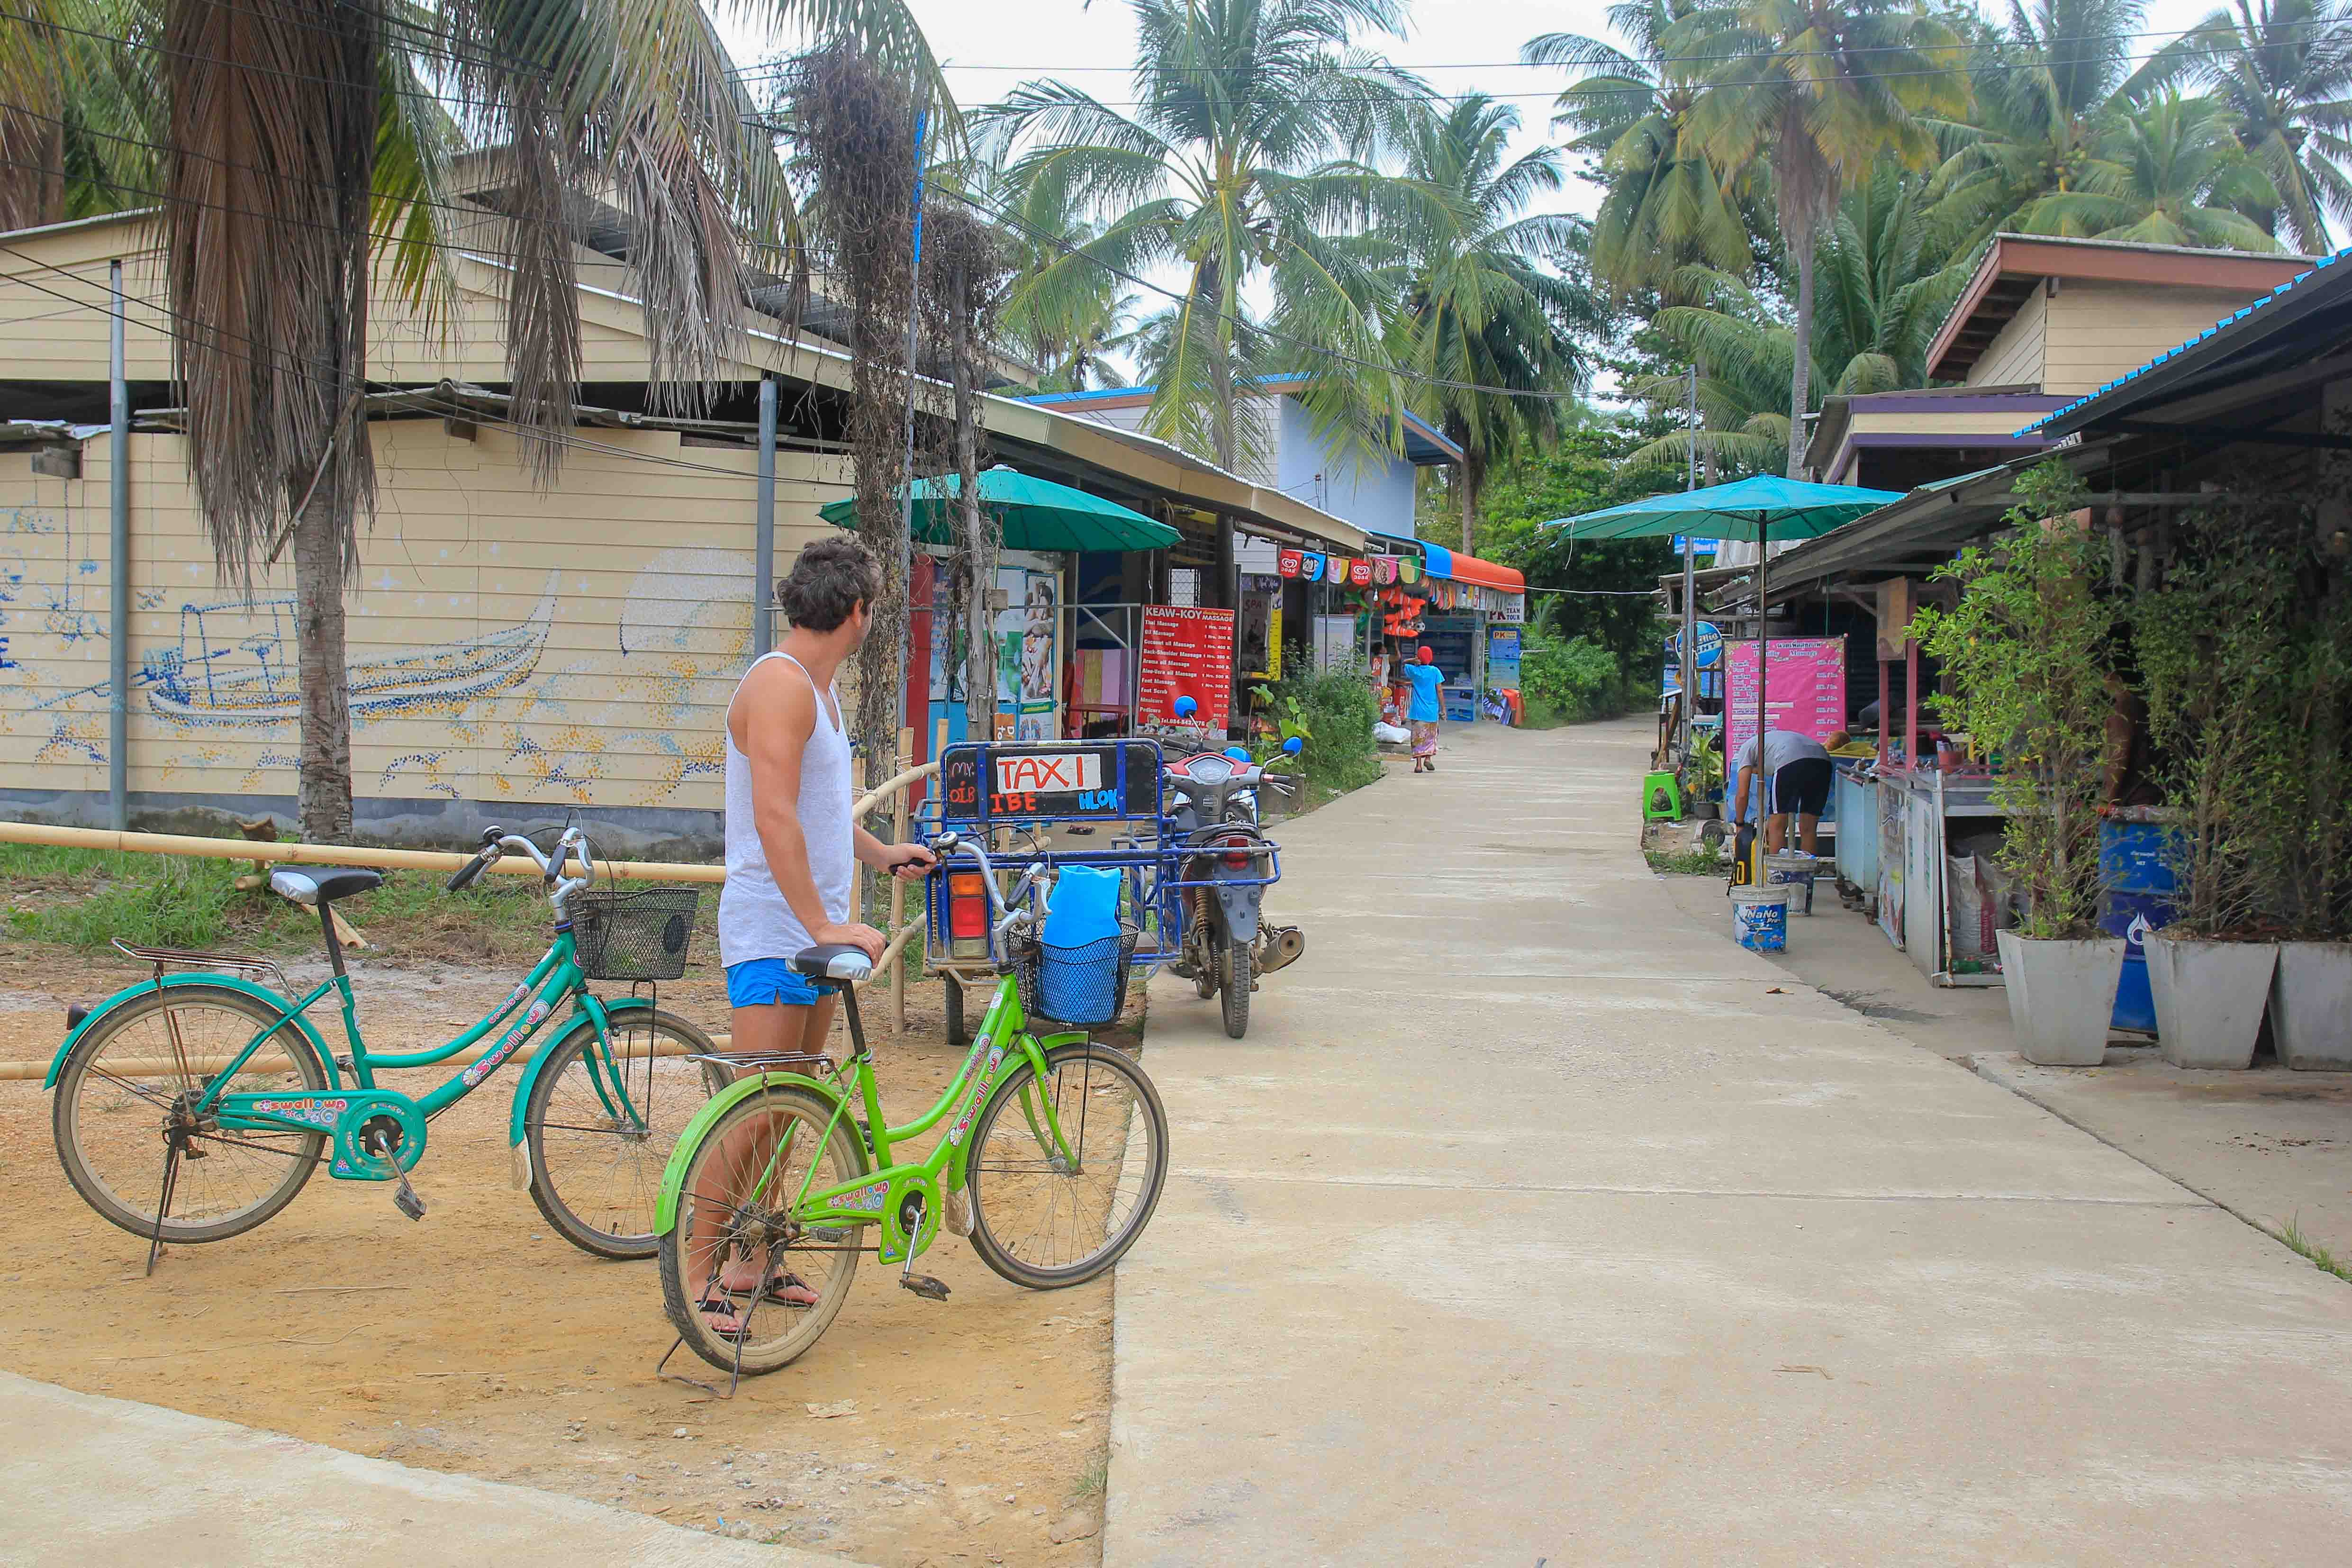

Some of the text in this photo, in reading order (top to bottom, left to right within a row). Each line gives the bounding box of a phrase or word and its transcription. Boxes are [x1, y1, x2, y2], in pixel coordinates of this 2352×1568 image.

[1146, 607, 1202, 619] KEAW-KOY
[998, 756, 1084, 789] TAXI
[988, 791, 1037, 813] IBE
